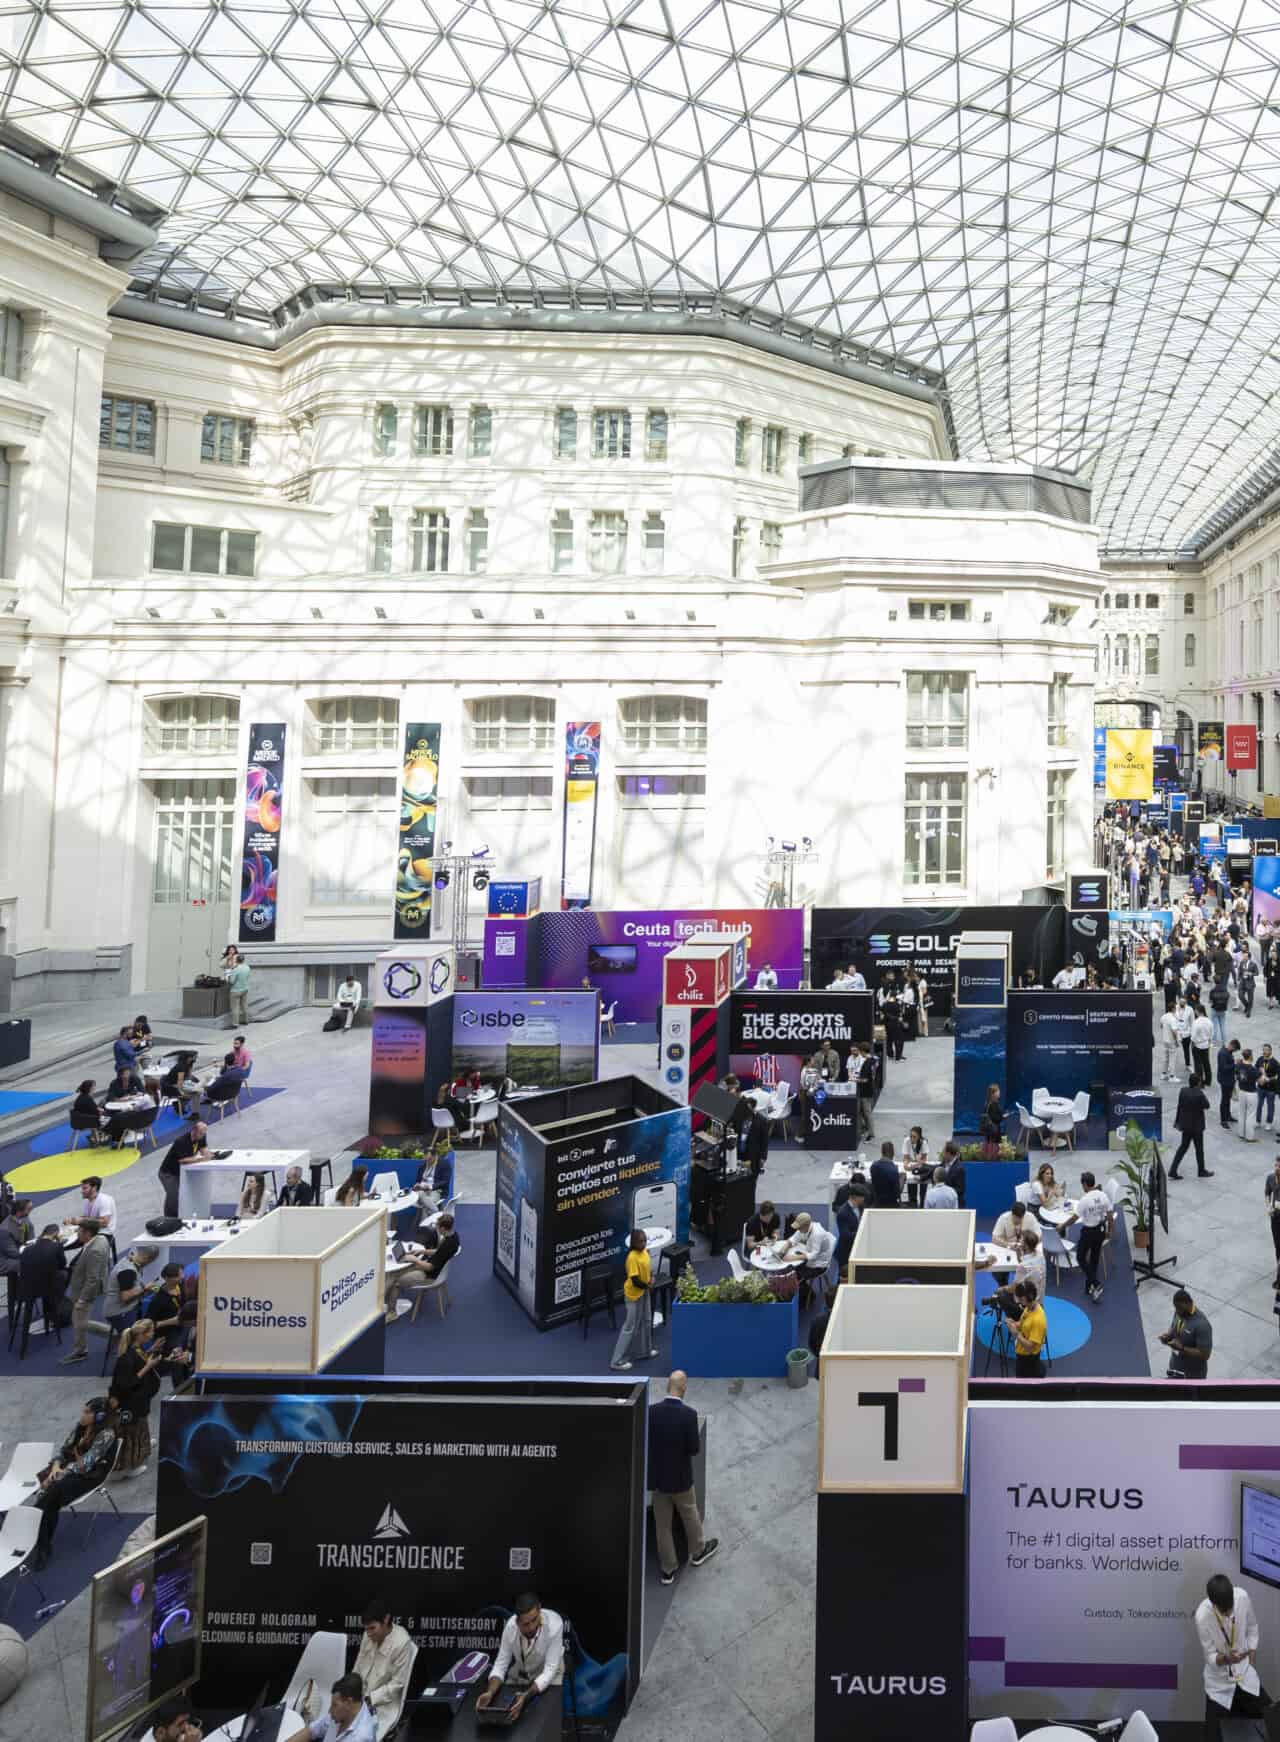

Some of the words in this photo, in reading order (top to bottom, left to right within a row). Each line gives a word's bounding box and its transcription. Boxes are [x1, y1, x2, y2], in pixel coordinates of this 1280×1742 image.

[623, 922, 671, 936] Ceuta
[678, 921, 713, 935] tech
[721, 920, 752, 935] hub
[897, 935, 961, 952] SOLA
[677, 989, 704, 1000] chiliz
[481, 1010, 526, 1028] isbe
[742, 1013, 775, 1026] THE
[779, 1013, 844, 1026] SPORTS
[742, 1026, 852, 1040] BLOCKCHAIN
[823, 1112, 852, 1126] chiliz
[558, 1160, 616, 1183] Convierte
[617, 1154, 636, 1166] tus
[557, 1178, 601, 1198] criptos
[602, 1174, 617, 1184] en
[557, 1200, 575, 1212] sin
[330, 1269, 375, 1312] business
[332, 1272, 357, 1297] bitso
[230, 1298, 273, 1312] bitso
[230, 1313, 307, 1328] business
[235, 1440, 303, 1453] TRANSFORMING
[305, 1441, 352, 1454] CUSTOMER
[354, 1442, 393, 1456] SERVICE,
[395, 1442, 424, 1456] SALES
[424, 1443, 432, 1456] &
[433, 1443, 485, 1456] MARKETING
[486, 1444, 509, 1456] WITH
[510, 1445, 520, 1456] AI
[522, 1446, 557, 1458] AGENTS
[1007, 1483, 1143, 1509] TAURUS
[1006, 1531, 1037, 1547] The
[1042, 1532, 1062, 1548] #1
[1066, 1532, 1114, 1551] digital
[1120, 1536, 1164, 1548] asset
[1168, 1534, 1240, 1552] platform
[316, 1544, 464, 1570] TRANSCENDENCE
[1006, 1554, 1030, 1570] for
[1034, 1554, 1086, 1570] banks.
[1092, 1555, 1183, 1572] Worldwide.
[207, 1612, 256, 1625] POWERED
[262, 1613, 317, 1626] HOLOGRAM
[420, 1616, 497, 1631] MULTISENSORY
[201, 1630, 246, 1644] ELCOMING
[256, 1632, 299, 1645] GUIDANCE
[430, 1636, 456, 1648] STAFF
[457, 1636, 500, 1649] WORKLOA
[830, 1673, 947, 1696] TAURUS
